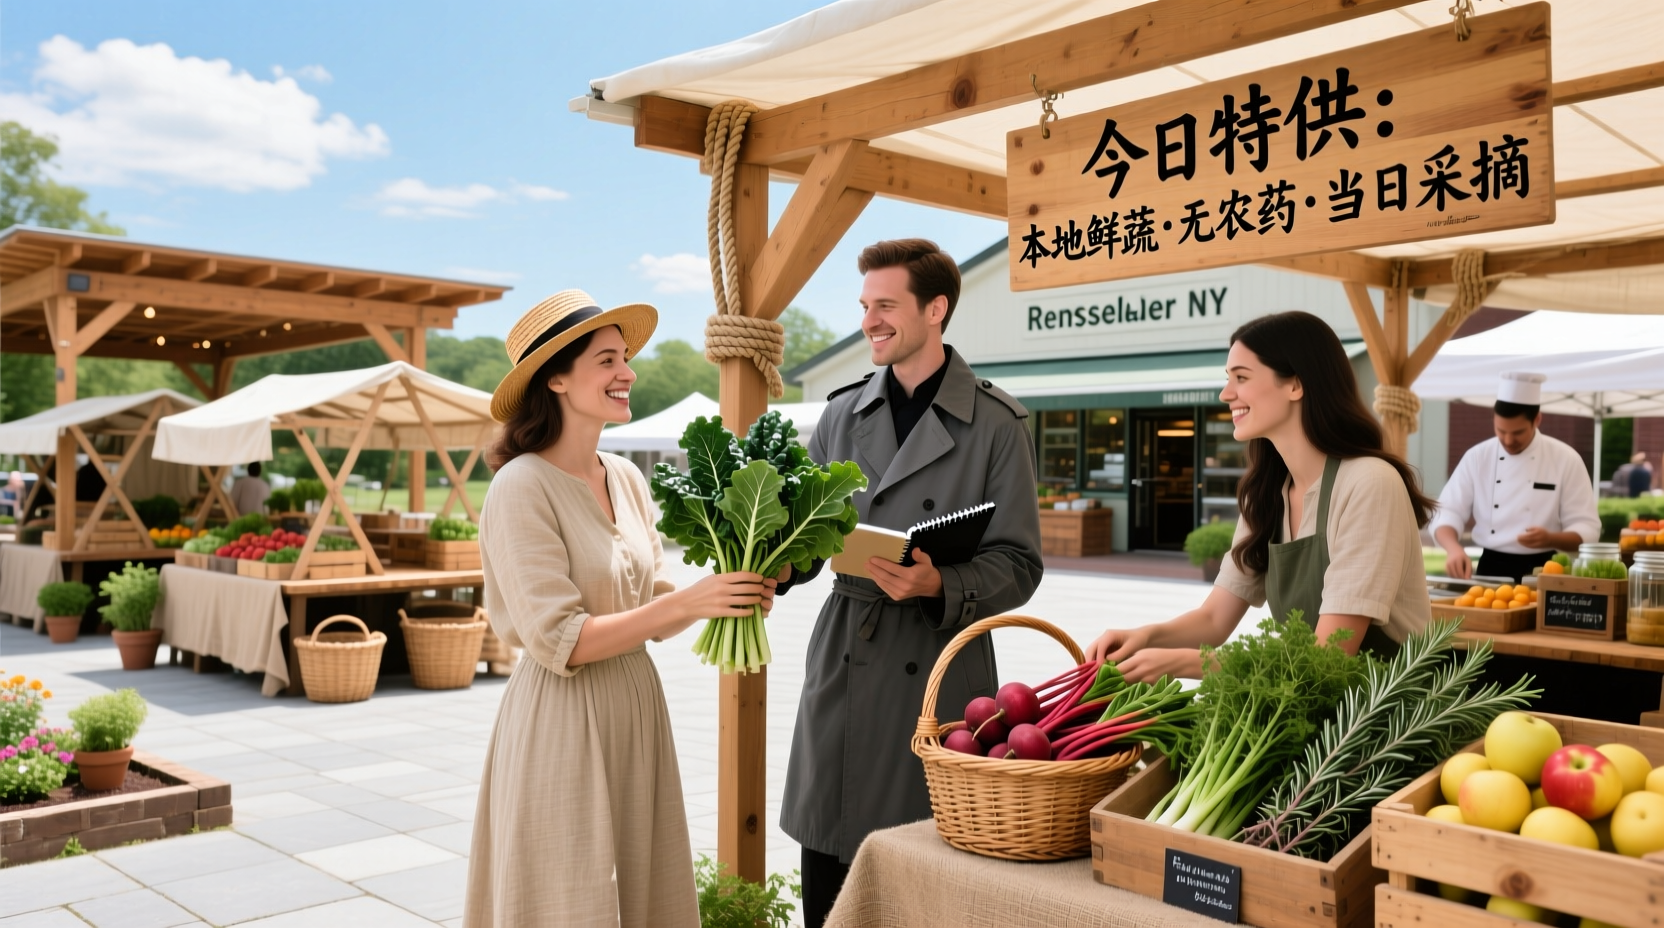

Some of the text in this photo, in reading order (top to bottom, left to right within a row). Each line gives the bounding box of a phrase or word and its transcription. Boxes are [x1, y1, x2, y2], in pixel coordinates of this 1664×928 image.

[1081, 66, 1395, 199] 今日特供：
[1018, 134, 1530, 269] 本地鲜蔬·无农药·当日采摘
[1188, 286, 1229, 318] NY
